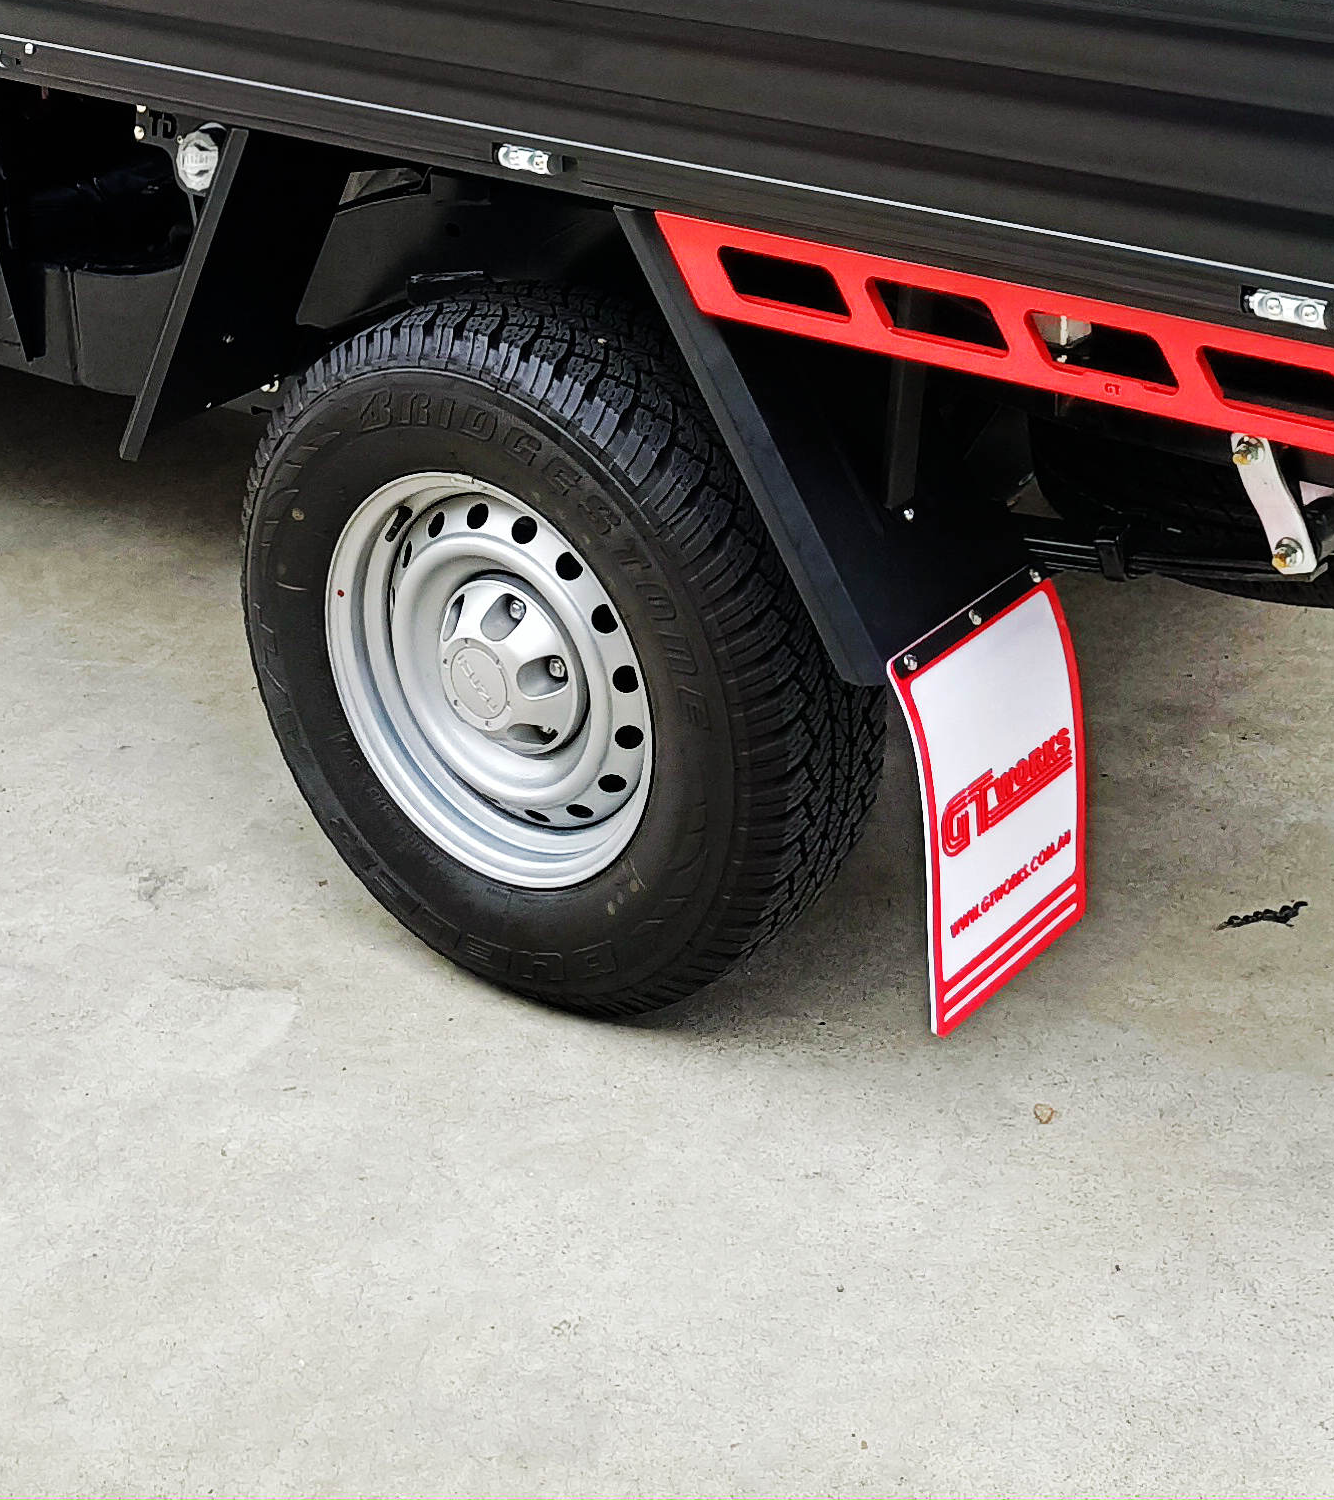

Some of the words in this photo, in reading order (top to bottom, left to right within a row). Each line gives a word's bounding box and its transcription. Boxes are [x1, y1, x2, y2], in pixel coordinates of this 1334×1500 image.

[1105, 383, 1120, 396] GT
[358, 388, 711, 733] BRIDGESTONE
[950, 829, 1072, 939] WWW.GTWORKS.COM.AU
